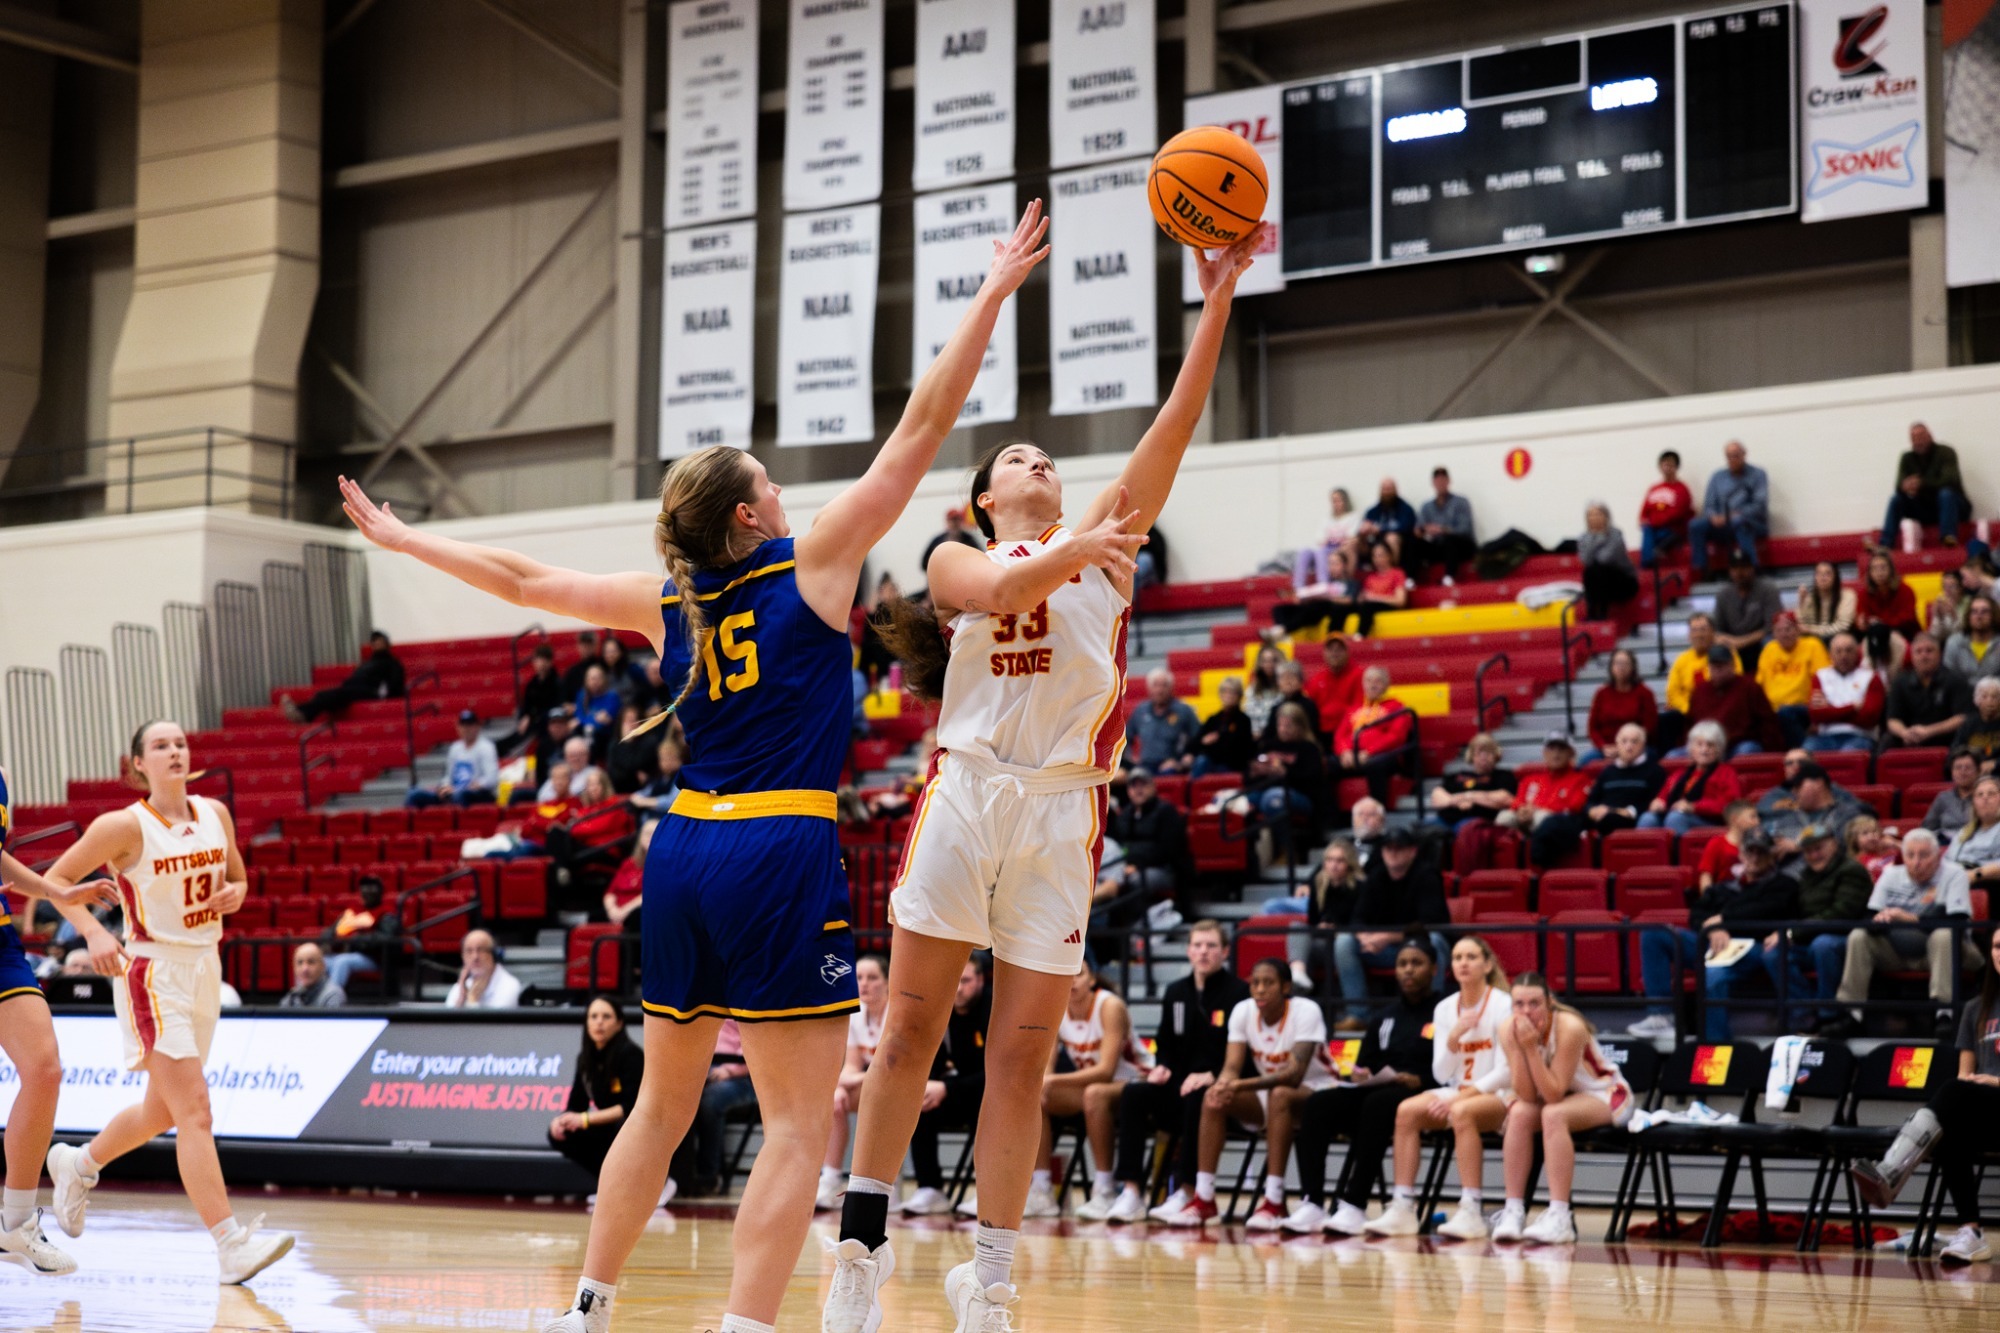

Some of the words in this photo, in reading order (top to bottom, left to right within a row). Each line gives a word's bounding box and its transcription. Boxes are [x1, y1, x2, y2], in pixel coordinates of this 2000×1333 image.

[1080, 4, 1124, 33] AAU
[943, 30, 986, 58] AAU
[1069, 67, 1135, 91] NATIONAL
[935, 93, 995, 115] NATIONAL
[1808, 77, 1917, 107] Craw-Kan
[1823, 147, 1902, 178] SONIC
[1058, 169, 1147, 197] VOLLEYBALL
[1487, 171, 1530, 191] PLAYER
[943, 196, 986, 216] MEN'S
[1172, 191, 1239, 241] Wilson
[811, 218, 852, 235] MEN'S
[923, 219, 1007, 244] BASKETBALL
[691, 233, 730, 250] MEN'S
[790, 241, 871, 263] BASKETBALL
[671, 257, 748, 279] BASKETBALL
[1076, 253, 1127, 281] NAIA
[804, 294, 851, 319] NAIA
[684, 308, 730, 333] NAIA
[1071, 320, 1134, 340] NATIONAL
[678, 370, 734, 386] NATIONAL
[797, 357, 855, 374] NATIONAL
[989, 598, 1050, 644] 33
[697, 609, 760, 702] 15
[990, 647, 1053, 677] STATE
[153, 848, 225, 875] PITTSBUR
[183, 872, 213, 907] 13
[370, 1049, 420, 1075] Enter
[418, 1055, 465, 1081] your
[464, 1051, 539, 1077] artwork
[538, 1054, 562, 1077] at
[1463, 1058, 1475, 1080] 2
[60, 1066, 117, 1085] ance
[206, 1062, 304, 1098] olarship.
